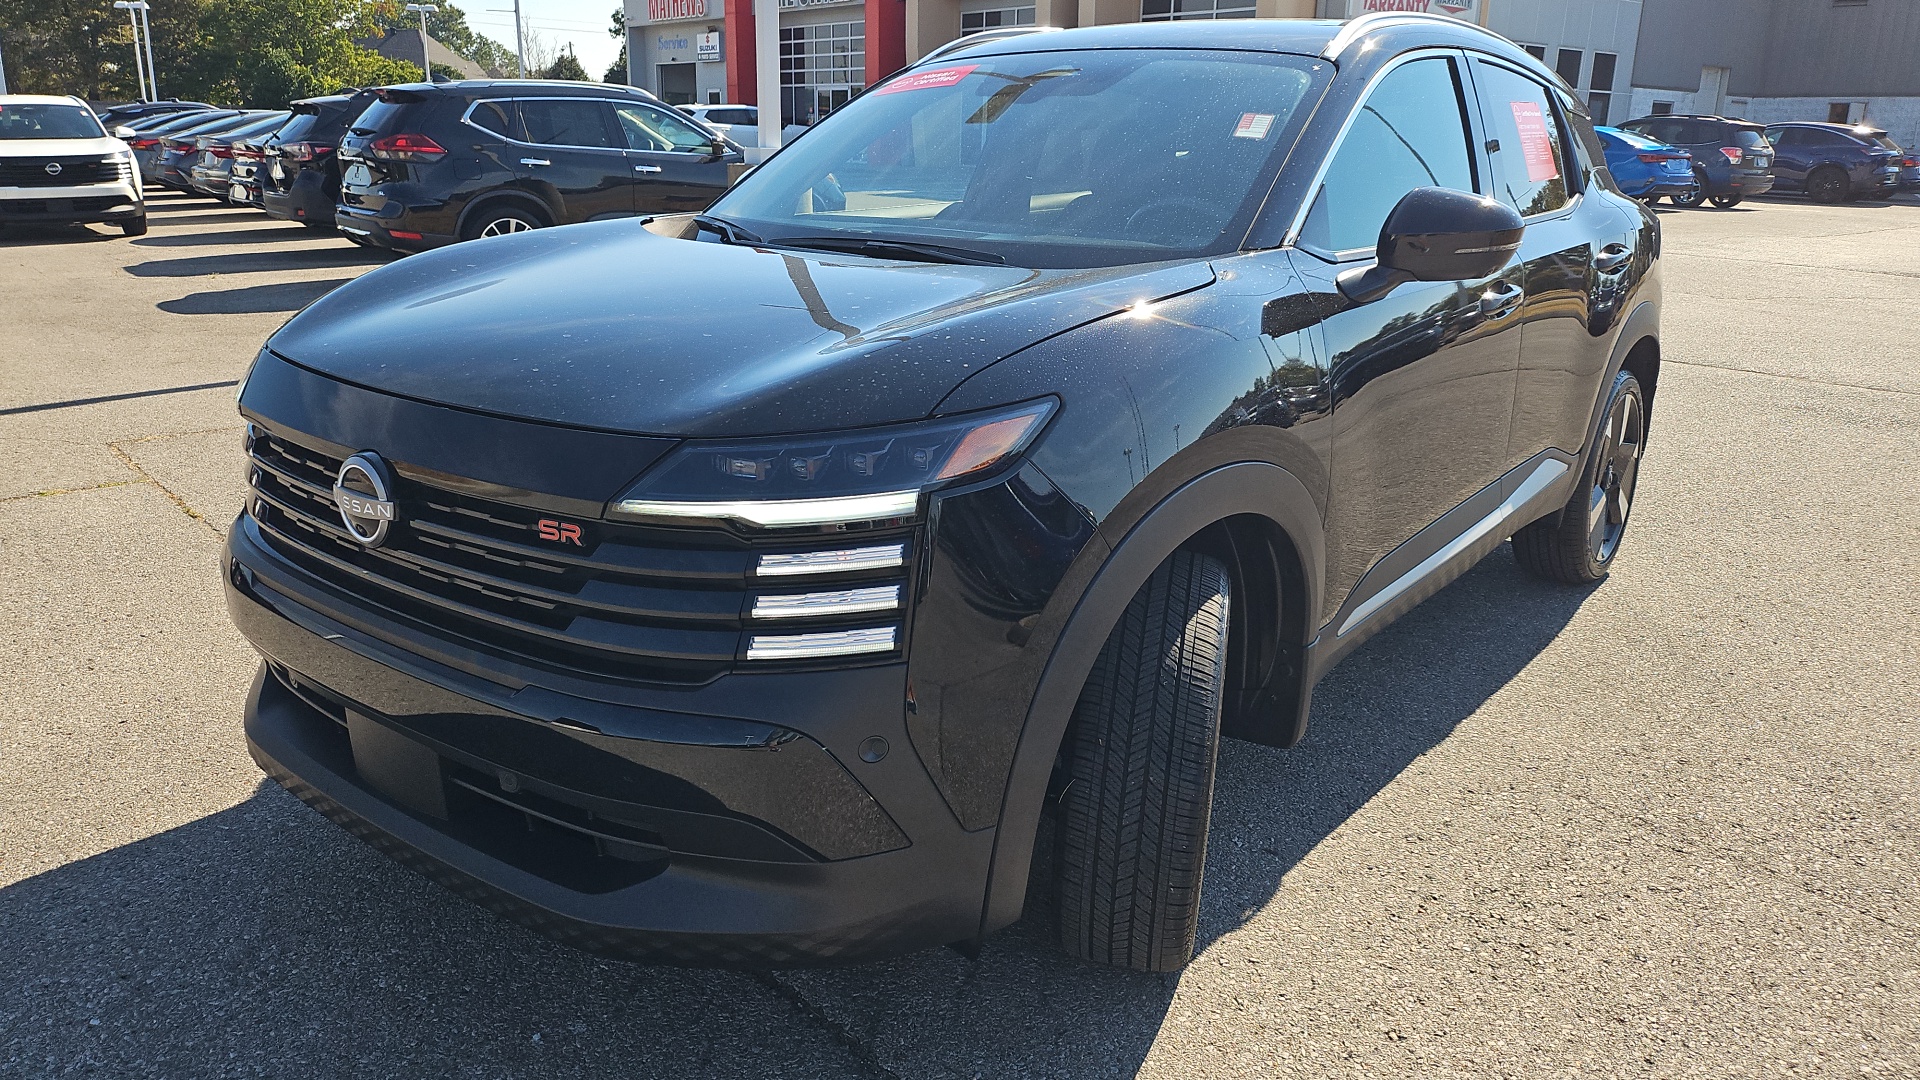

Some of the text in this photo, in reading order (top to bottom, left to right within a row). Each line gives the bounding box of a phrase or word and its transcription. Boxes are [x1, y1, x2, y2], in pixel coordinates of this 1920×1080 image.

[648, 0, 705, 21] MATHEWS
[658, 34, 688, 51] Service
[699, 44, 718, 52] SUZUKI
[340, 493, 391, 518] SSAN
[538, 519, 583, 547] SR
